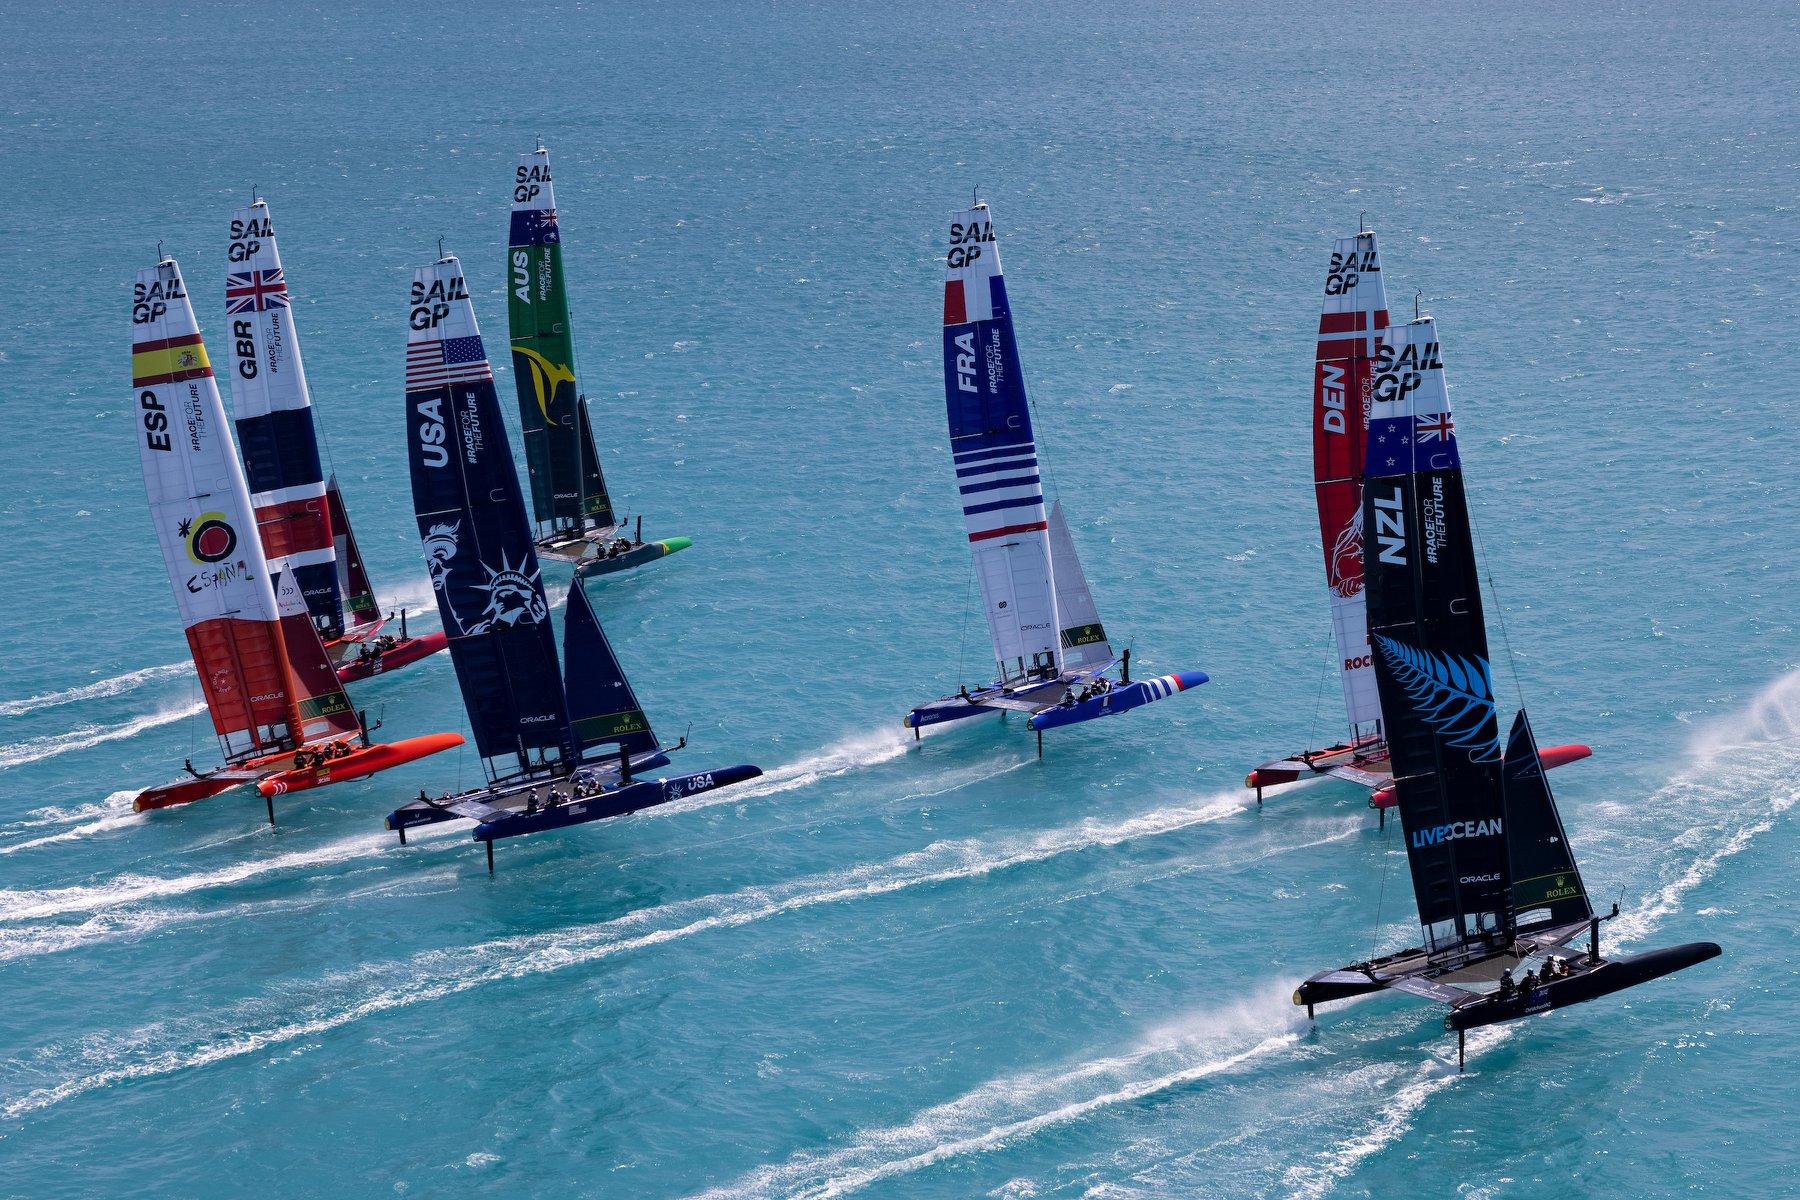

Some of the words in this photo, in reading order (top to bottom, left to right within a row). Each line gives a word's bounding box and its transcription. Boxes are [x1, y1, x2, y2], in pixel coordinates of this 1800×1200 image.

[515, 165, 552, 184] SAIL
[514, 185, 540, 202] GP
[230, 218, 274, 240] SAIL
[949, 221, 996, 245] SAIL
[228, 241, 260, 262] GP
[947, 246, 982, 269] GP
[1329, 251, 1380, 273] SAIL
[512, 250, 531, 305] AUS
[1325, 273, 1360, 296] GP
[134, 279, 186, 304] SAIL
[410, 277, 470, 305] SAIL
[132, 302, 167, 324] GP
[410, 304, 450, 331] GP
[233, 320, 258, 380] GBR
[1375, 342, 1444, 373] SAIL
[954, 332, 978, 394] FRA
[1372, 372, 1422, 402] GP
[1322, 364, 1346, 434] DEN
[140, 390, 172, 452] ESP
[417, 398, 449, 468] USA
[554, 492, 578, 500] ORACLE
[1374, 486, 1407, 566] NZL
[303, 586, 332, 596] ORACLE
[1020, 622, 1051, 632] ORACLE
[1077, 634, 1100, 644] ROLEX
[250, 691, 285, 702] ORACLE
[322, 703, 346, 714] ROLEX
[520, 713, 556, 724] ORACLE
[613, 722, 642, 734] ROLEX
[687, 774, 714, 790] USA
[1459, 872, 1501, 884] ORACLE
[1546, 886, 1577, 898] ROLEX
